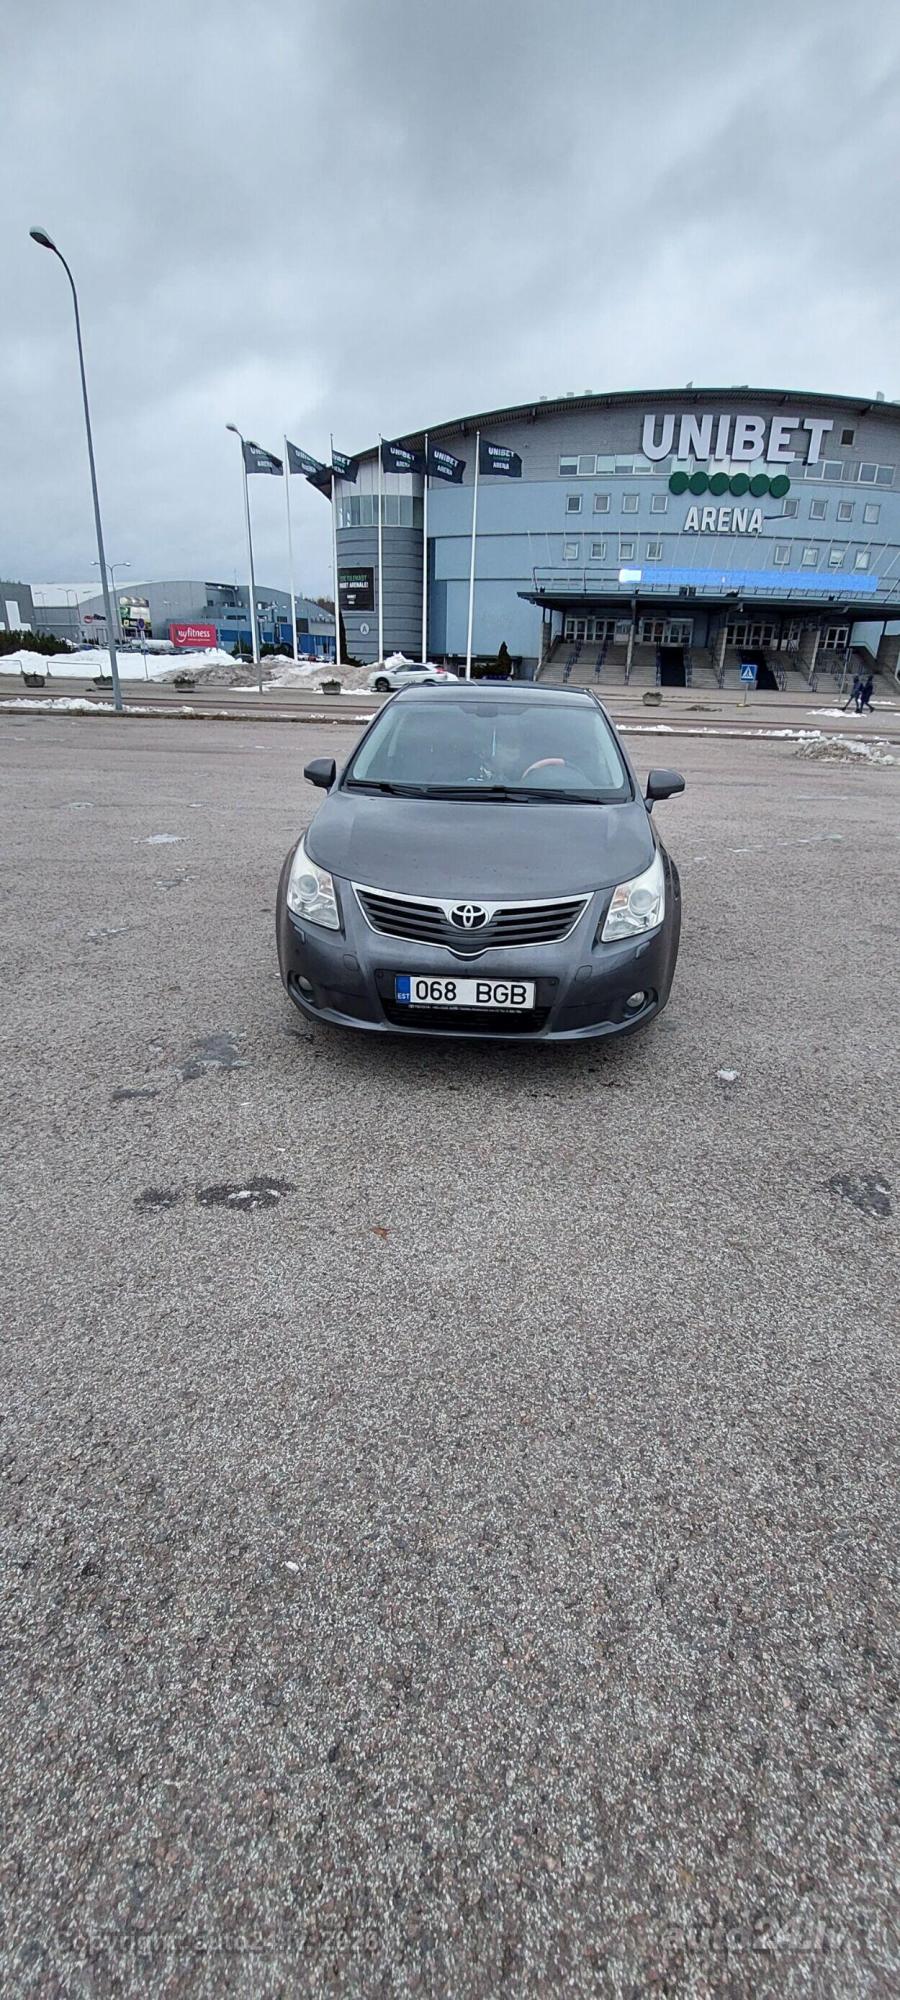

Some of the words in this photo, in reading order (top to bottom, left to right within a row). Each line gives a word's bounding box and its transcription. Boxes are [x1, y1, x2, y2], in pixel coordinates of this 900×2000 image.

[642, 414, 834, 464] UNIBET
[434, 450, 459, 467] UNIBET
[488, 447, 514, 457] UNIBET
[492, 462, 510, 470] ARENA
[683, 506, 764, 533] ARENA
[415, 980, 457, 1001] 068
[475, 982, 527, 1005] BGB
